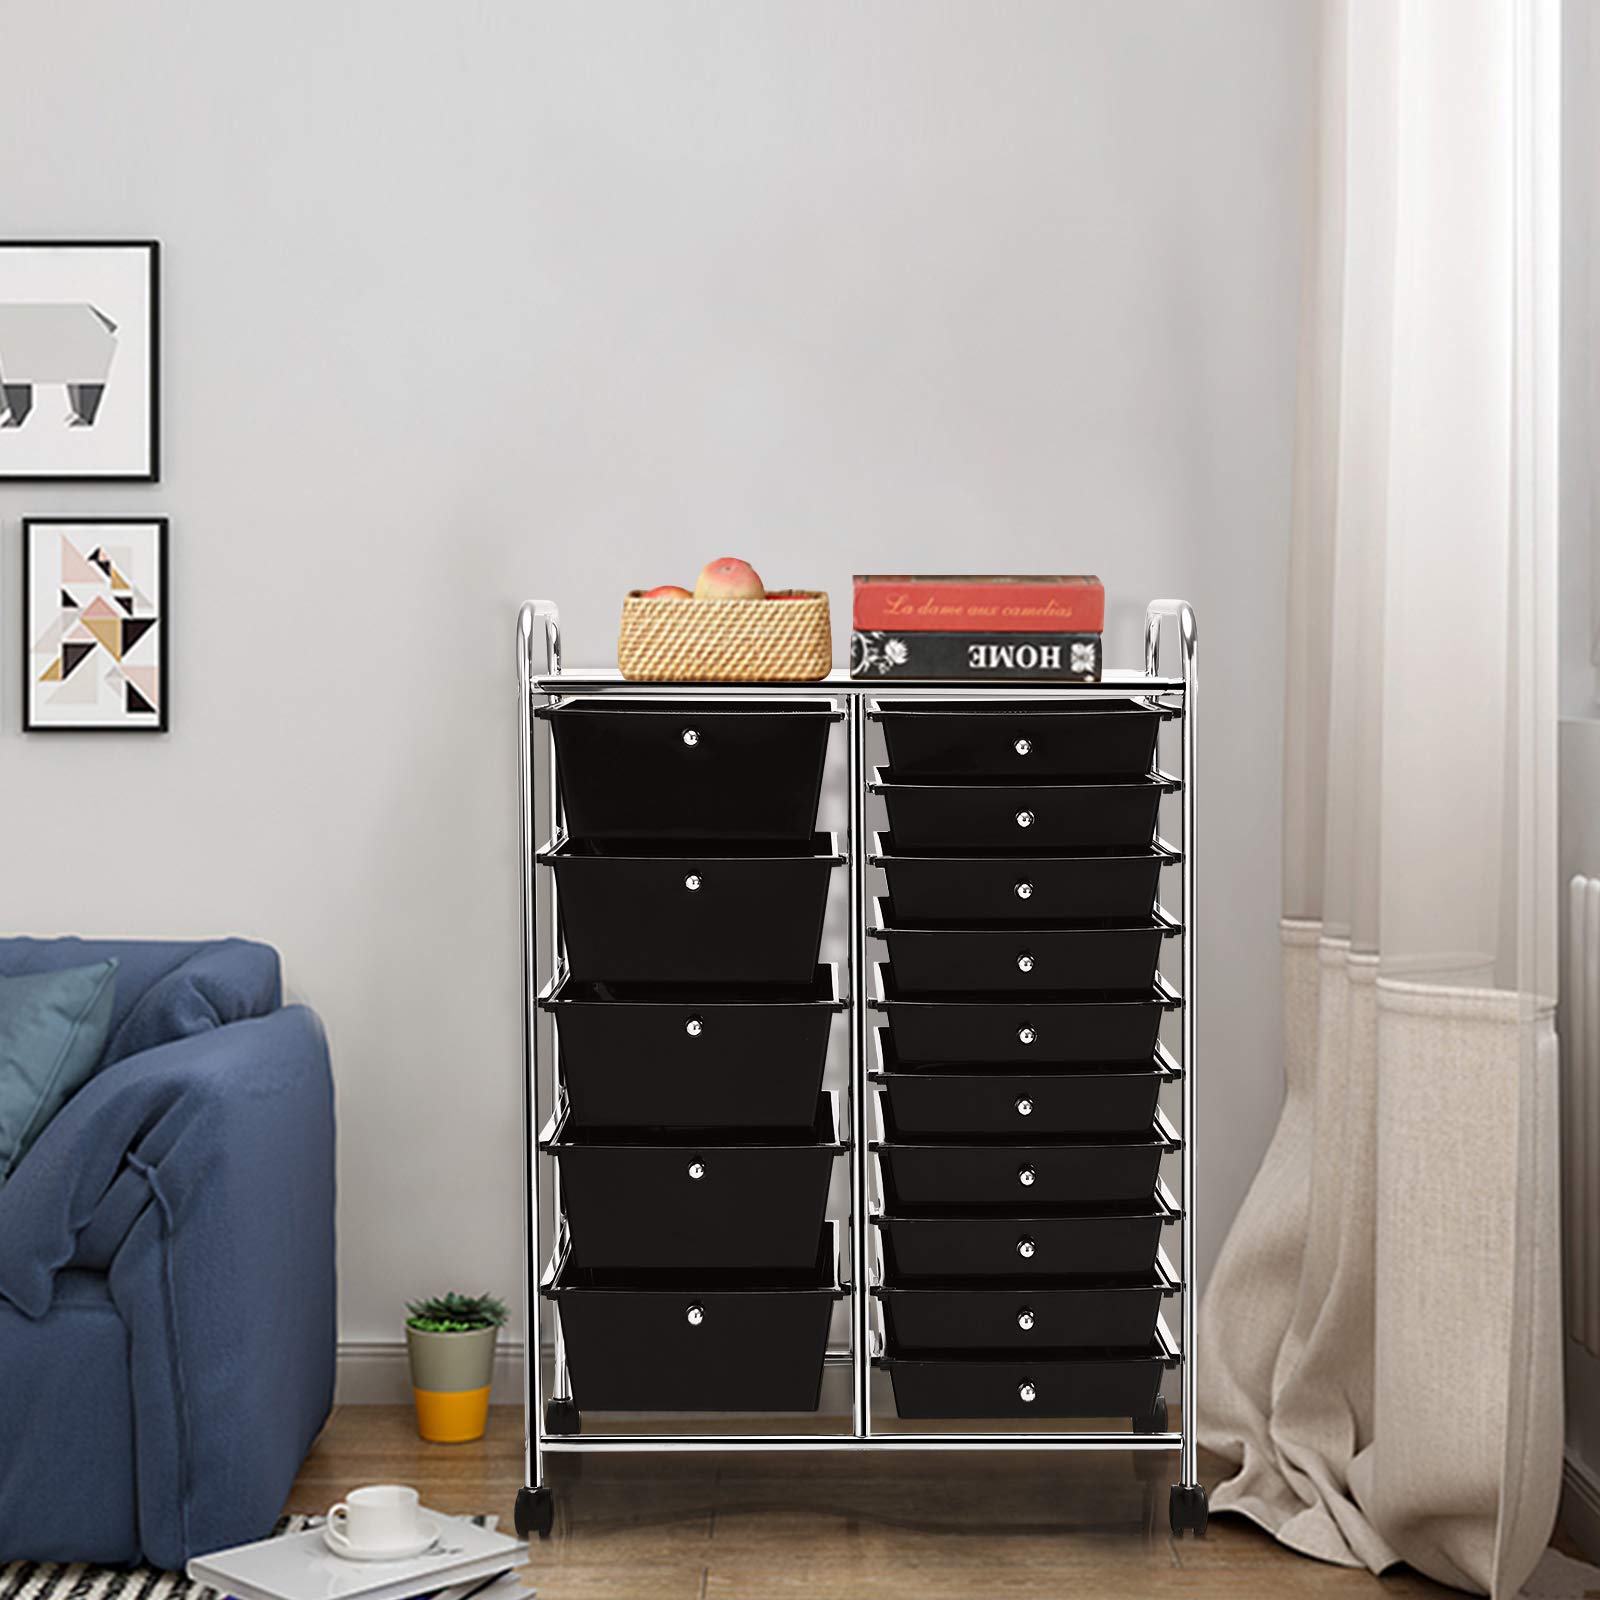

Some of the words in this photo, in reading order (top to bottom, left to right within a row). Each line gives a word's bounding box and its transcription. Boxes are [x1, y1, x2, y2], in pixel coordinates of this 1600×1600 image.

[884, 593, 913, 616] La
[917, 596, 962, 616] dame
[967, 605, 997, 617] aux
[1001, 598, 1073, 618] camelias
[968, 644, 1061, 669] HOME
